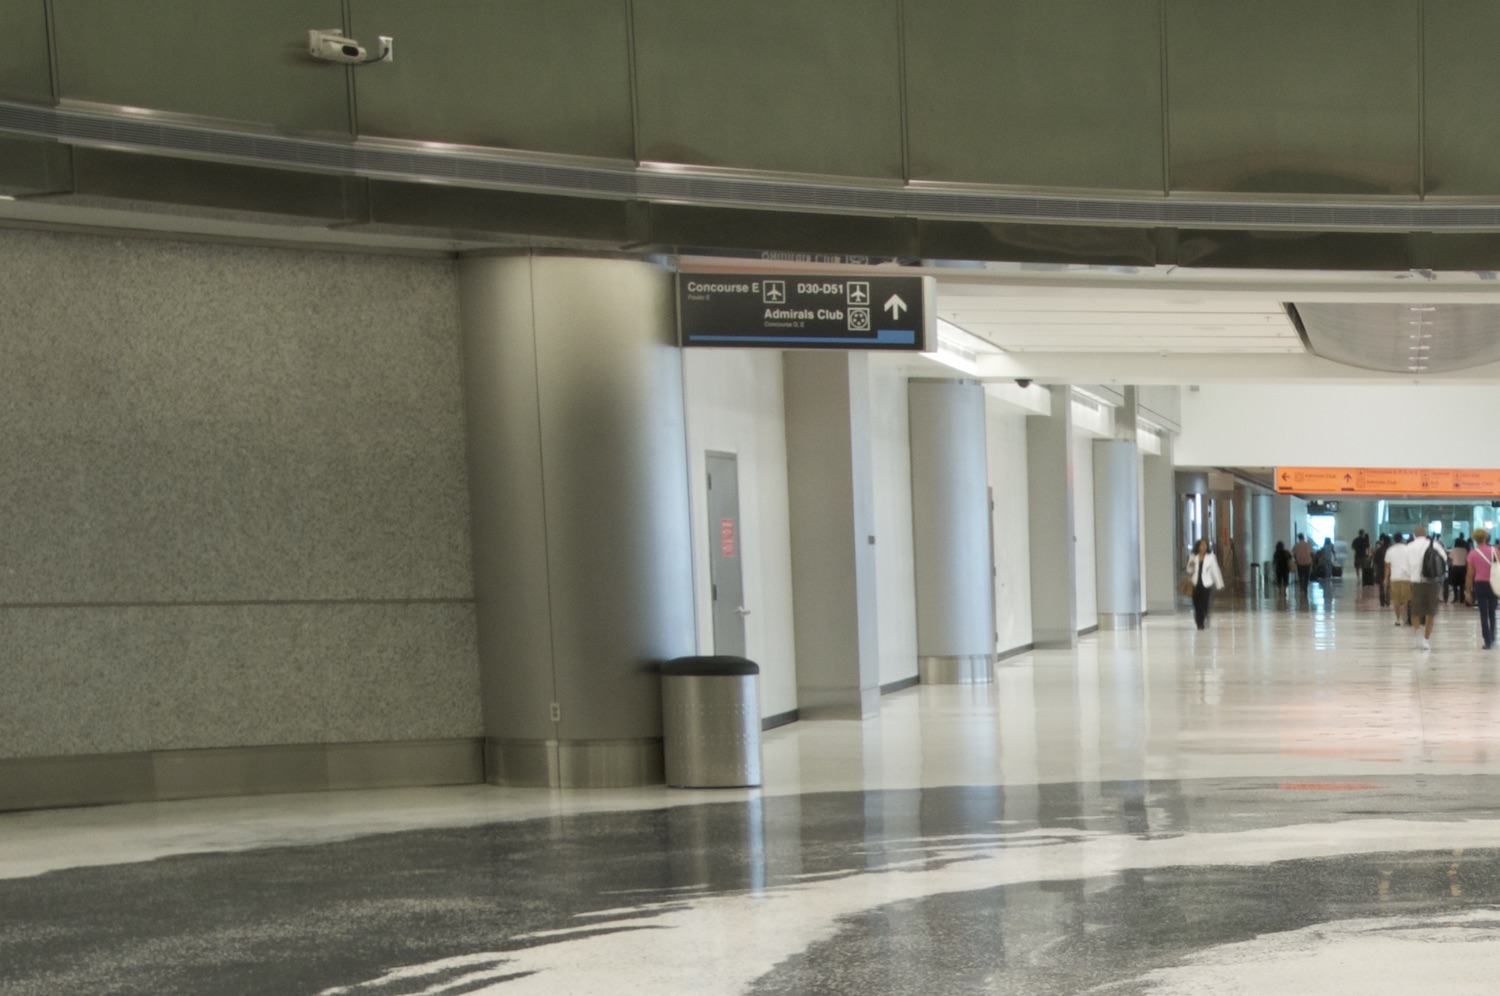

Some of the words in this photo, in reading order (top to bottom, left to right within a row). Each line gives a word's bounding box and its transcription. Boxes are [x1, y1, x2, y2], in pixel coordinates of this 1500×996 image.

[688, 281, 749, 293] Concourse
[752, 282, 760, 293] E
[798, 283, 844, 295] D30-D51
[765, 308, 815, 320] Admirals
[817, 308, 844, 320] Club
